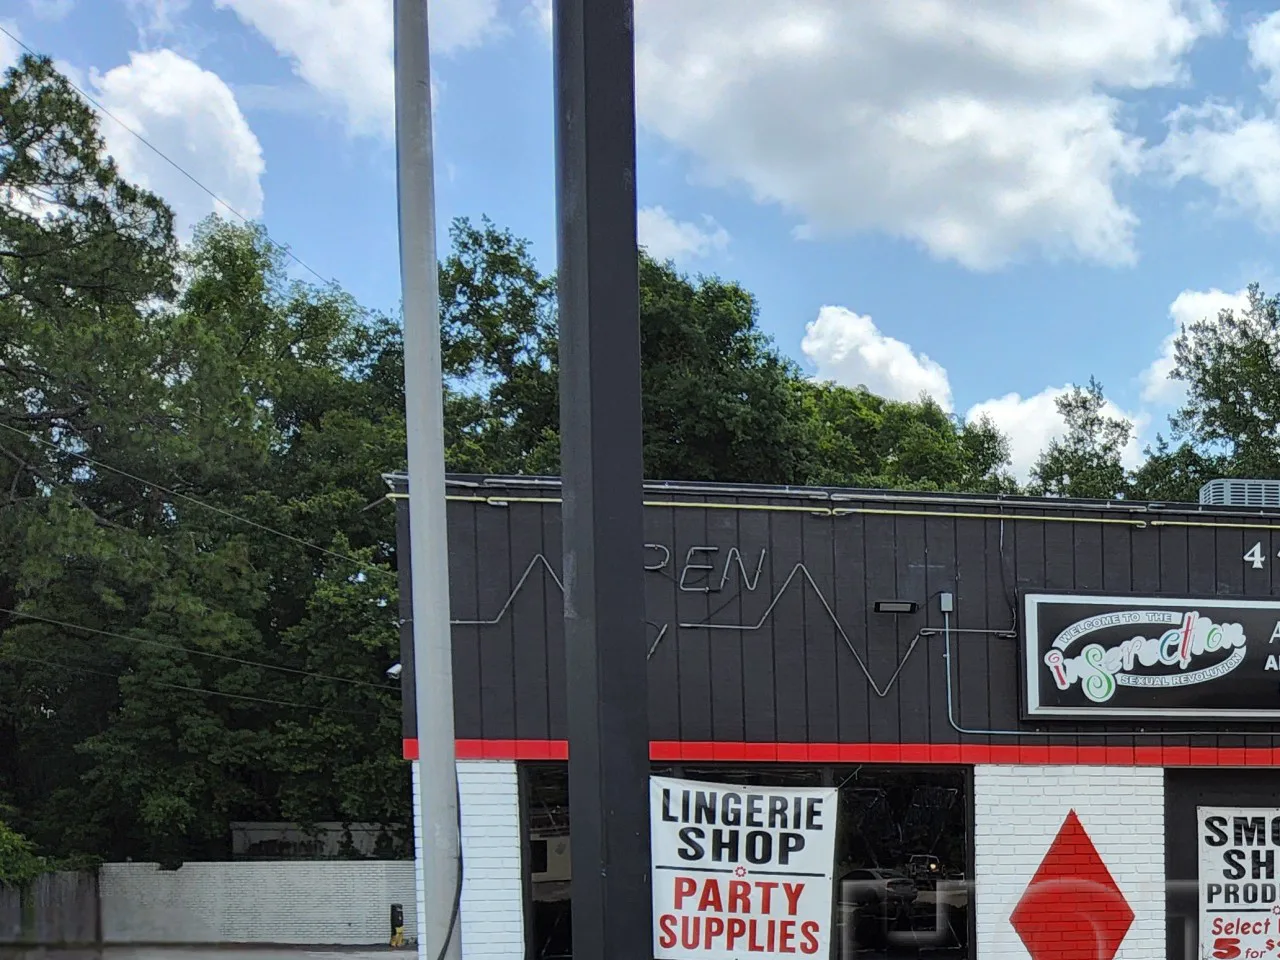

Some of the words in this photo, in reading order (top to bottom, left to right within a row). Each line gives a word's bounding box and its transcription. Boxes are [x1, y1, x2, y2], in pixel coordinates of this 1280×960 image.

[643, 543, 766, 591] PEN
[1059, 613, 1121, 644] WELCOME
[1122, 613, 1140, 623] TO
[1147, 613, 1172, 622] THE
[1120, 675, 1170, 686] SEXUAL
[1172, 653, 1243, 685] REVOLUTION
[661, 788, 824, 830] LINGERIE
[677, 826, 806, 865] SHOP
[674, 876, 806, 916] PARTY
[659, 914, 820, 955] SUPPLIES
[1211, 917, 1271, 935] Select
[1212, 937, 1242, 960] 5
[1245, 948, 1266, 959] for
